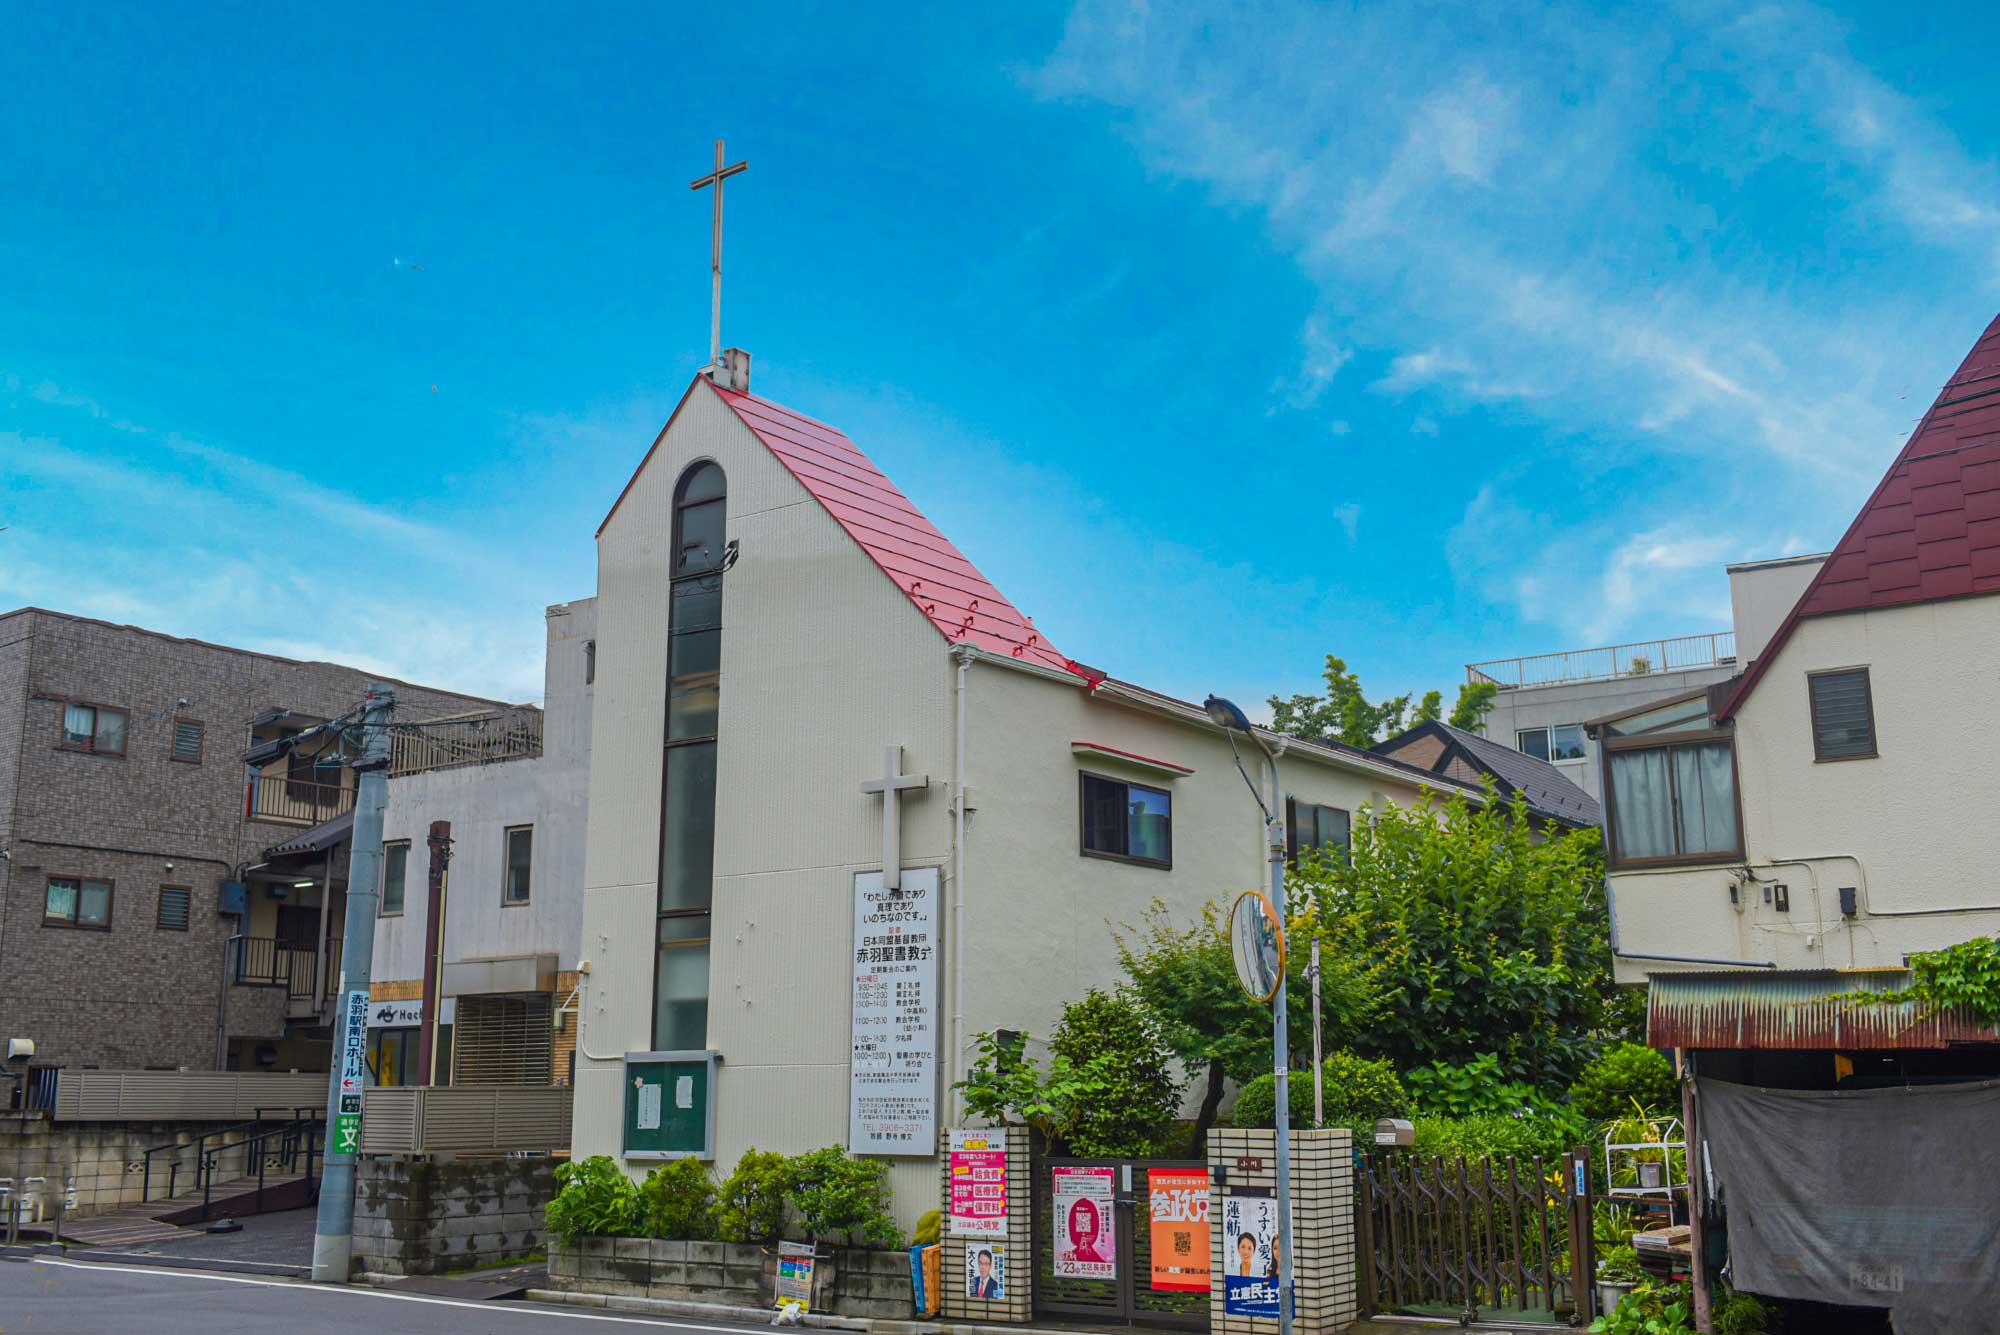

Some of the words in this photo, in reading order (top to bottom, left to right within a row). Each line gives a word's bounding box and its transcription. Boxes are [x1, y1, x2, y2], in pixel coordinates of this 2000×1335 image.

[877, 901, 914, 912] 真理であり
[863, 911, 927, 923] いのちなのです。」
[863, 933, 927, 946] 日本同盟基督教団
[344, 994, 364, 1077] 赤羽駅南口ホール
[974, 1169, 999, 1180] 給食費
[975, 1202, 1000, 1213] 保育料
[1150, 1188, 1211, 1223] 参政党
[1226, 1200, 1241, 1238] 蓮舫
[976, 1221, 1000, 1231] 公明党
